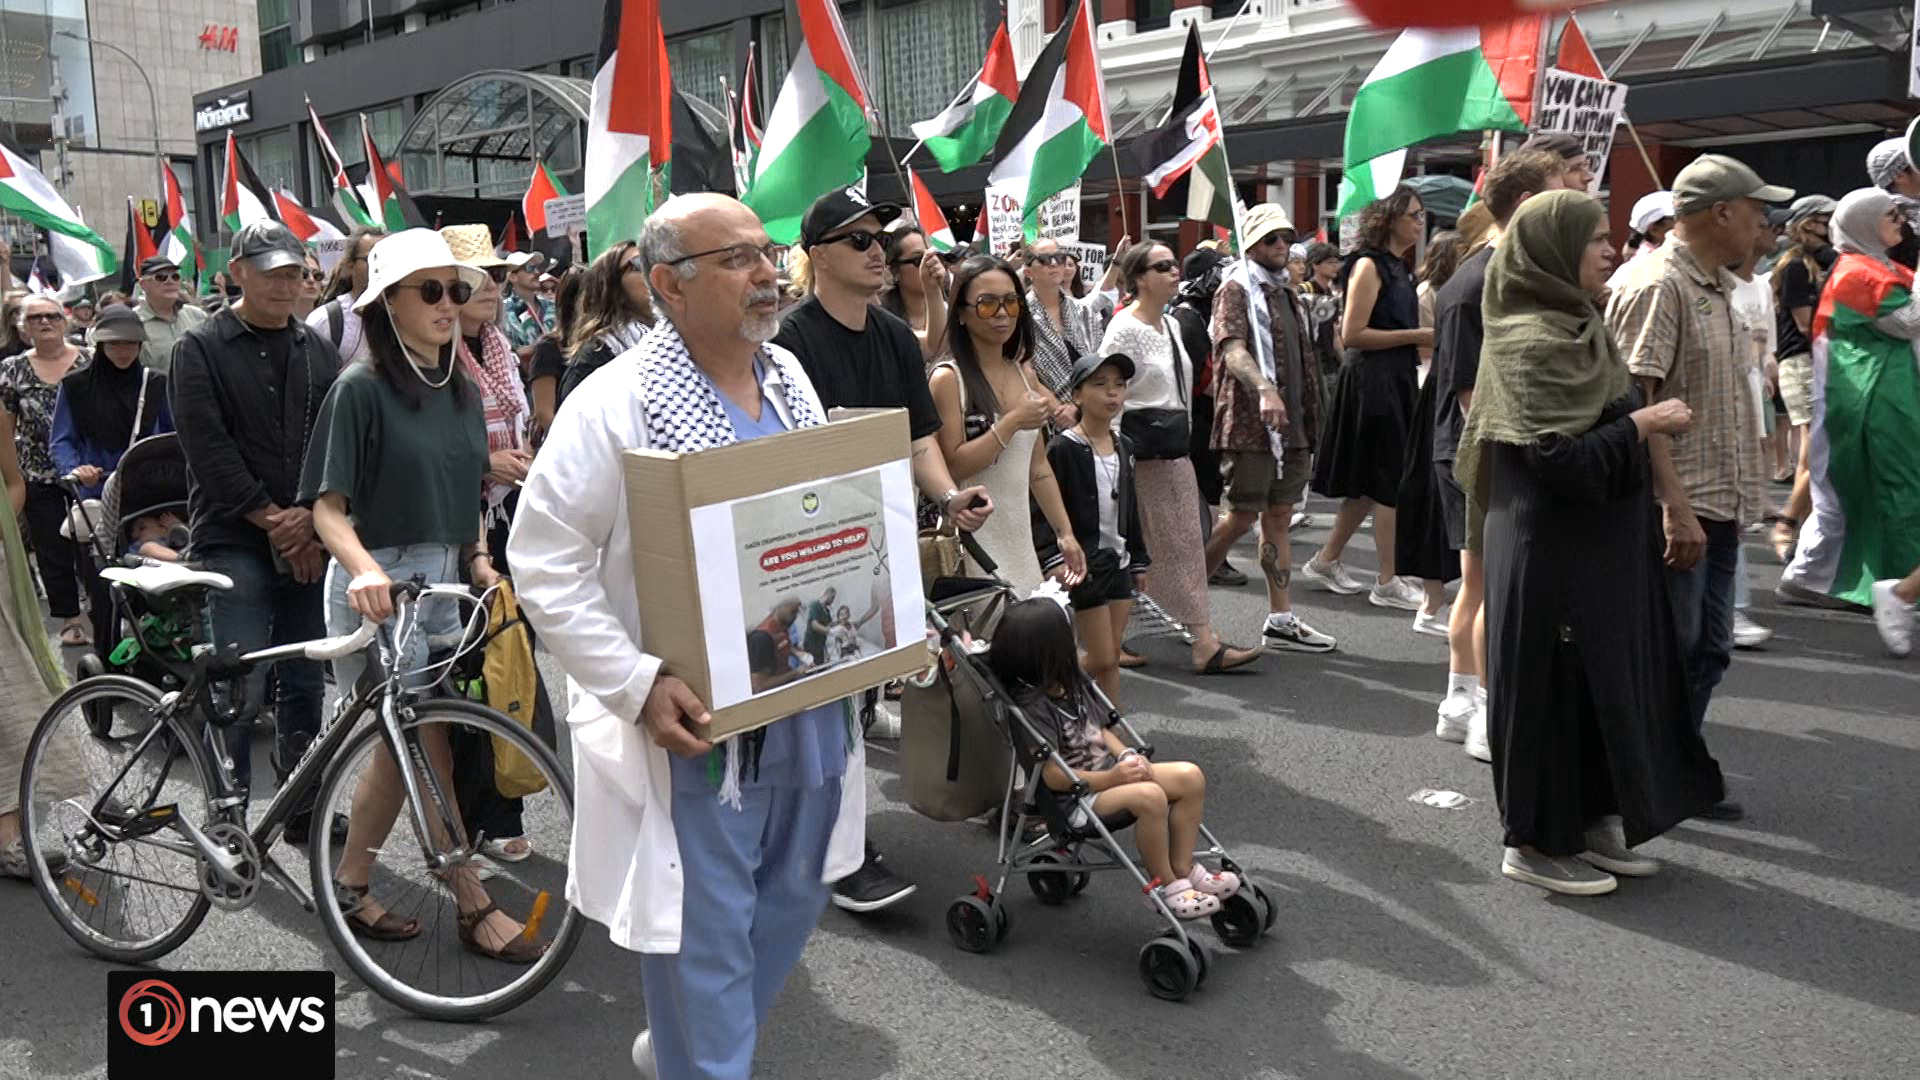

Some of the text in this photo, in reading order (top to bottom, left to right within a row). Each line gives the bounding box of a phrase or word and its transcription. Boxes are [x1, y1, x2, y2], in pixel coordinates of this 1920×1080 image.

[1545, 76, 1576, 106] YOU
[1574, 111, 1615, 134] NATION
[1085, 248, 1104, 265] FOR
[763, 532, 865, 567] ARE YOU WILLING TO HELP?
